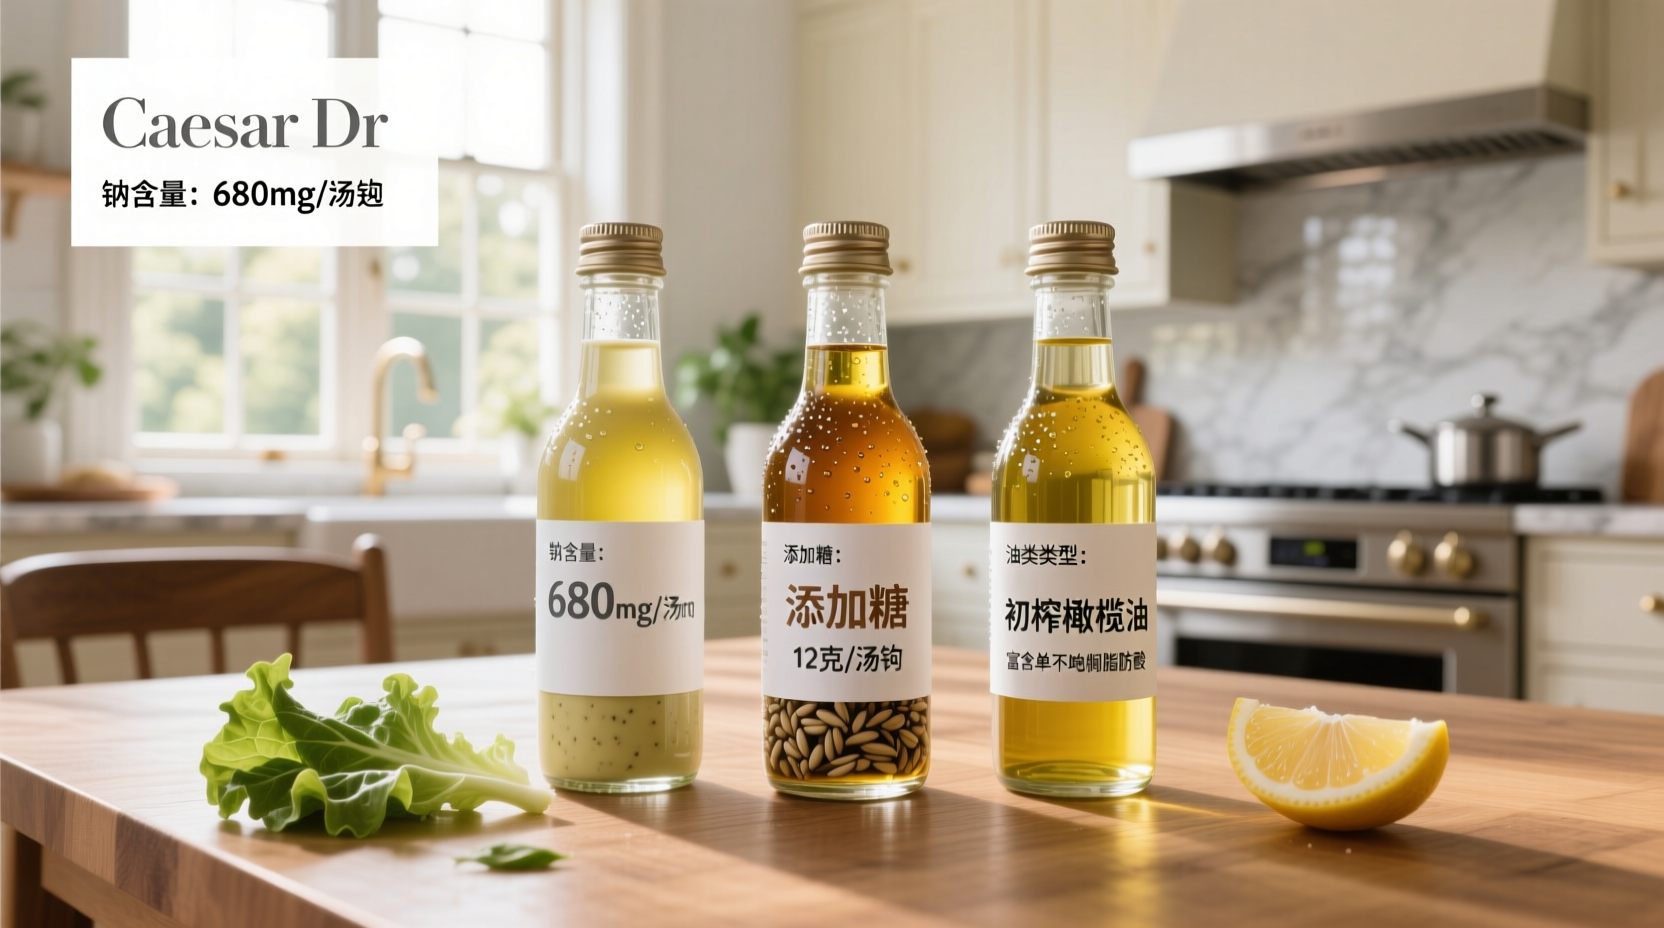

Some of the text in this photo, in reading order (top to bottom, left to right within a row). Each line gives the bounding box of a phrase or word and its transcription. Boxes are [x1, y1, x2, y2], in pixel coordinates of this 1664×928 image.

[785, 583, 910, 630] 添加糖
[1004, 597, 1149, 635] 初榨橄榄油
